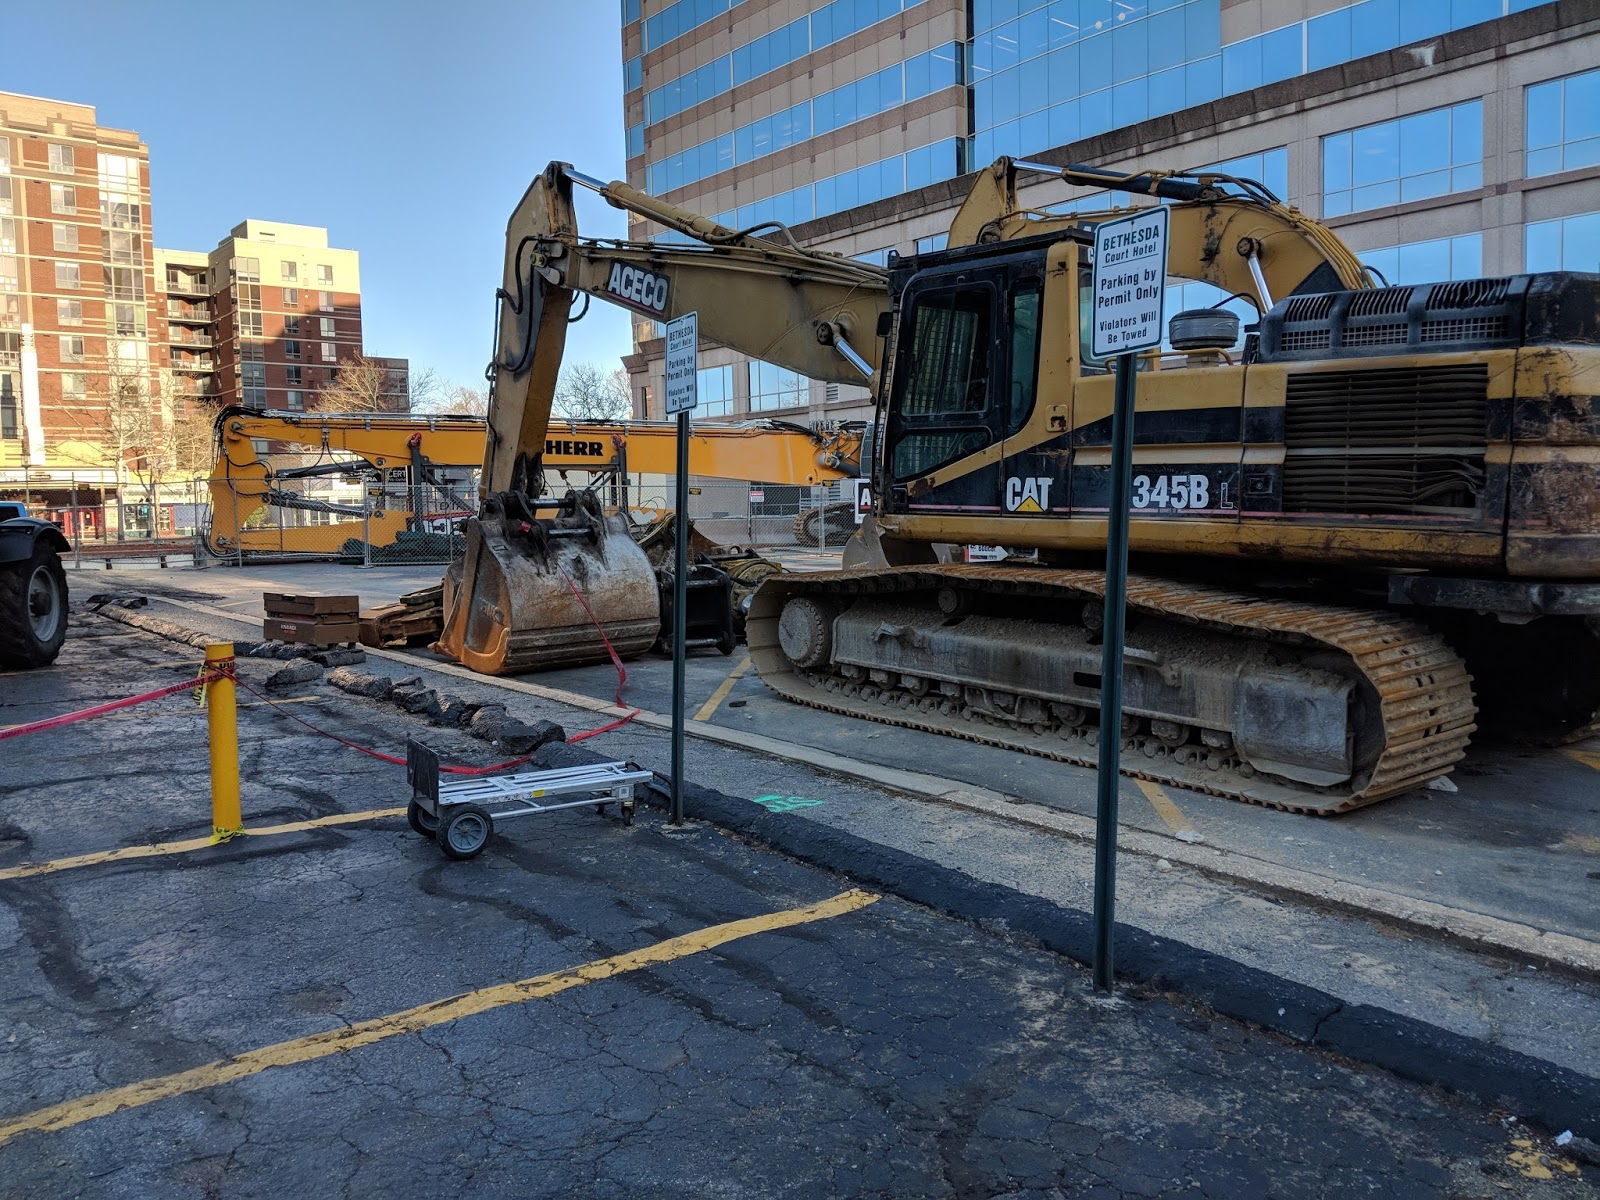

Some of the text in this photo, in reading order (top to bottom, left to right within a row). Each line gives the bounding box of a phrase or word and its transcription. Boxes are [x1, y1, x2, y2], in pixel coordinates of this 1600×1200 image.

[1103, 224, 1160, 252] BETHESDA
[1105, 241, 1157, 264] Court Hotel
[607, 262, 668, 311] ACECO
[1101, 268, 1157, 291] Parking by
[1098, 285, 1159, 308] Permit Only
[1099, 310, 1157, 332] Violators Will
[669, 325, 694, 341] BETHESDA
[1107, 326, 1147, 345] Be Towed
[668, 355, 693, 370] Parking by
[668, 367, 694, 381] Permit Only
[1006, 476, 1053, 511] CAT
[1132, 474, 1209, 509] 345B
